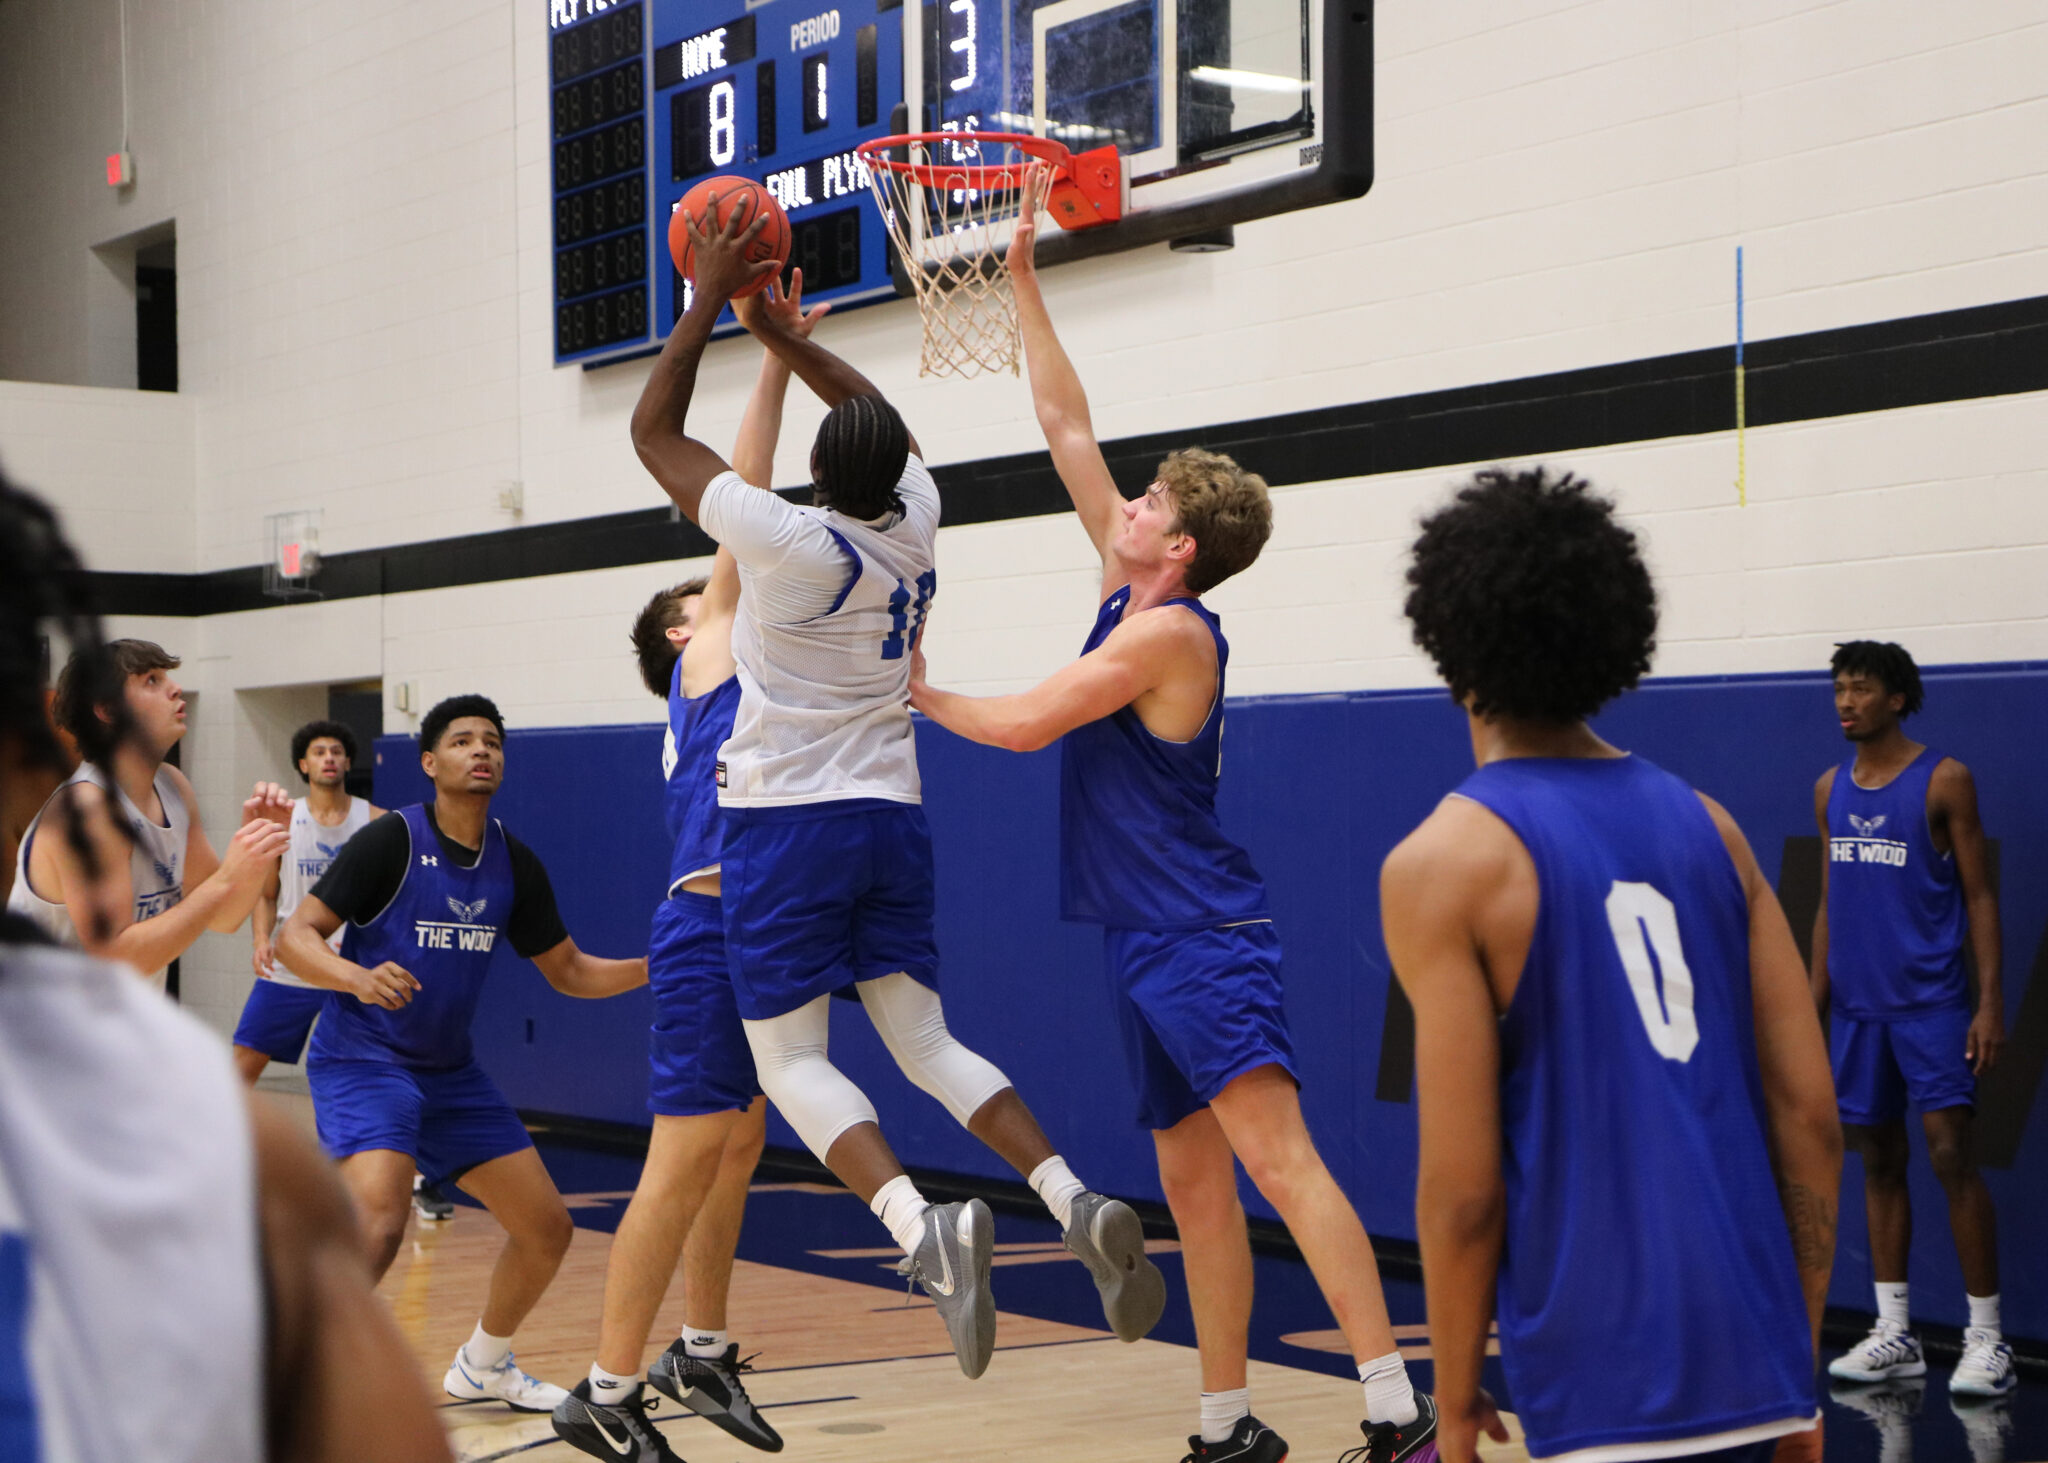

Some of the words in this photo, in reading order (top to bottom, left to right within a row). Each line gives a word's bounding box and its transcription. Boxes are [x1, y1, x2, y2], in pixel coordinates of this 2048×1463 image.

[682, 27, 727, 80] HOME
[791, 9, 840, 53] PERIOD
[817, 62, 827, 120] 1
[709, 81, 735, 167] 8
[415, 926, 454, 949] THE
[1605, 879, 1699, 1063] 0
